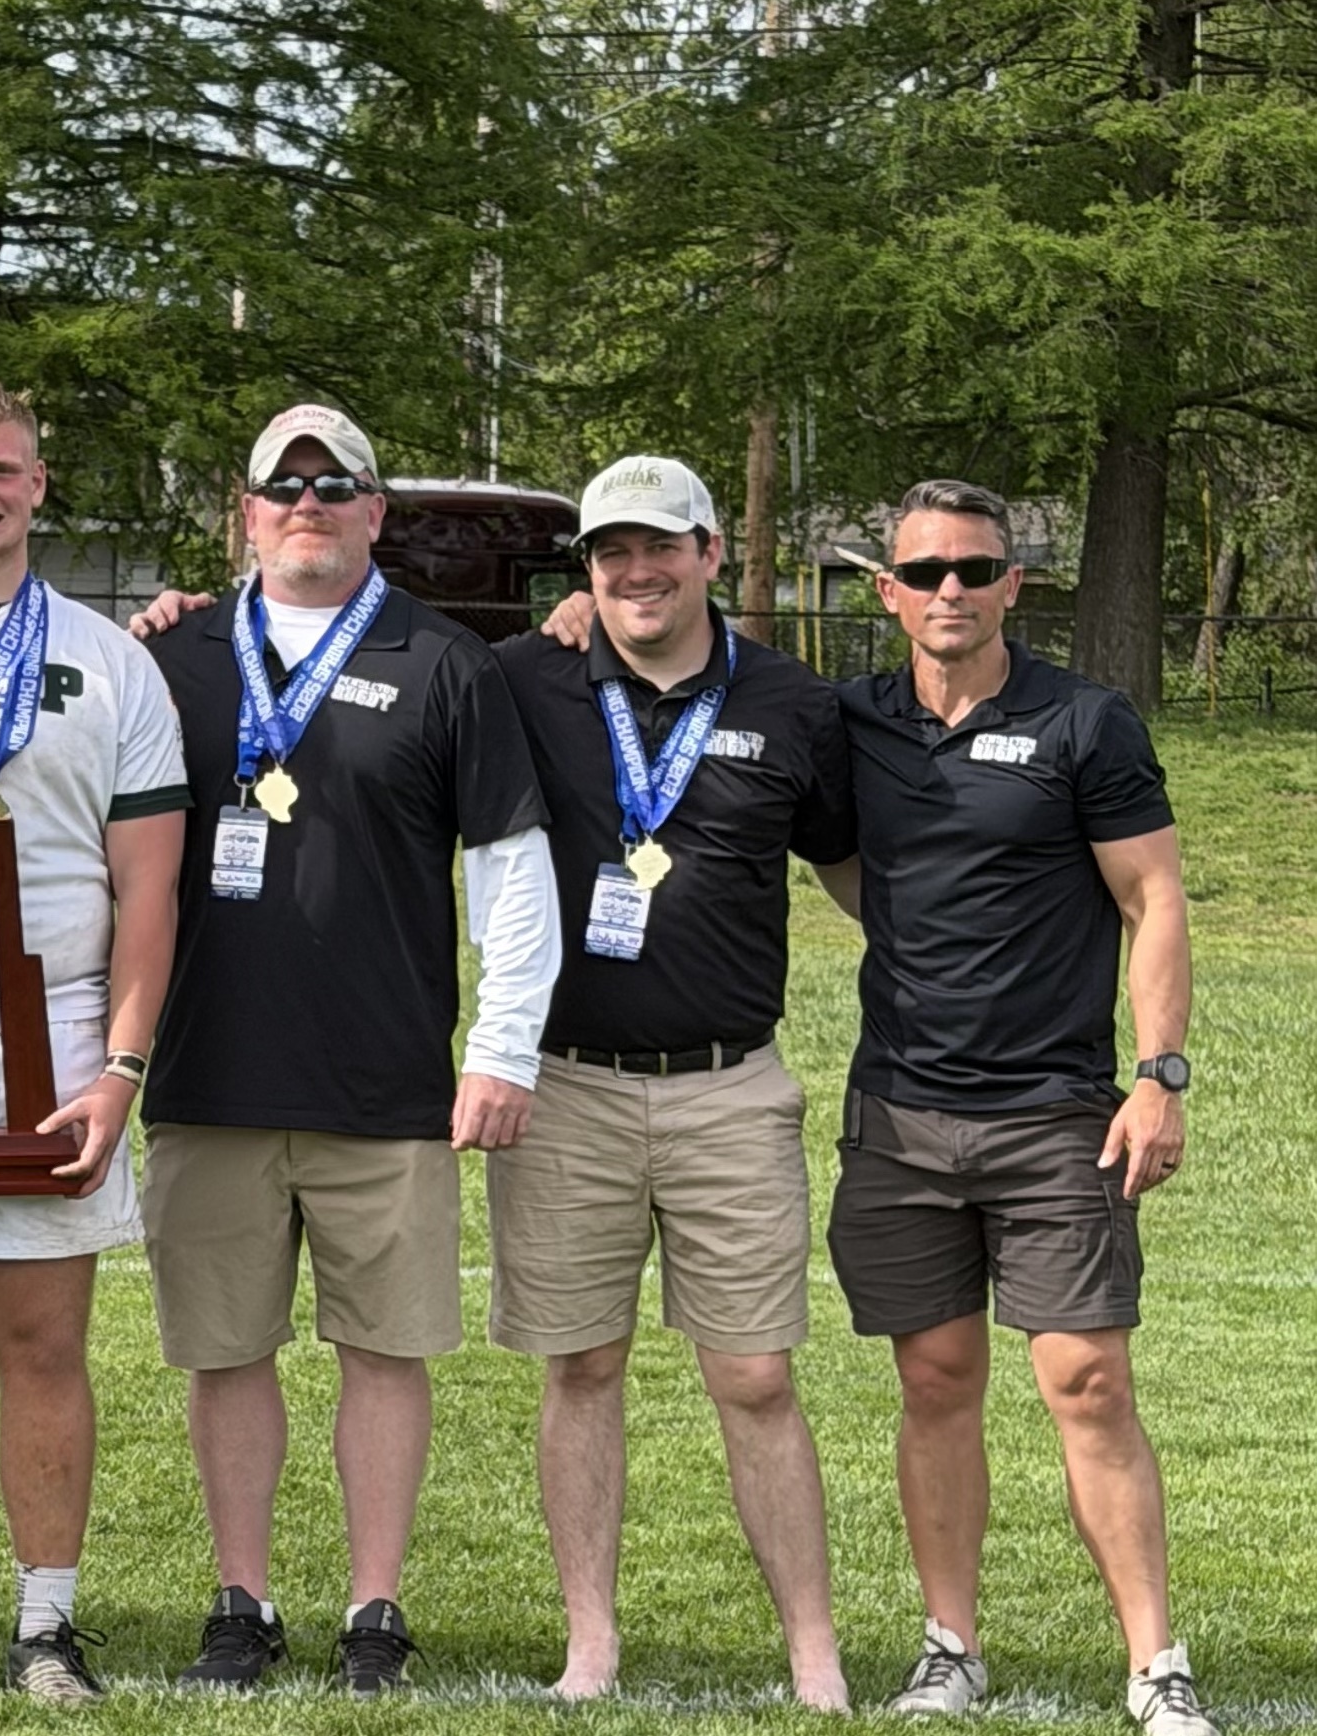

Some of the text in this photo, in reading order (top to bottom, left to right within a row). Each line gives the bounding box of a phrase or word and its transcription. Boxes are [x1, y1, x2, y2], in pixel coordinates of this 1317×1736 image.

[40, 662, 84, 716] P
[241, 649, 275, 723] CHAMPION
[287, 680, 323, 723] 2026
[311, 630, 354, 684] SPRING
[330, 684, 397, 712] RUGBY
[8, 677, 38, 751] CHAMPION
[659, 754, 692, 799] 2026
[678, 702, 715, 757] SPRING
[611, 712, 650, 794] CHAMPION
